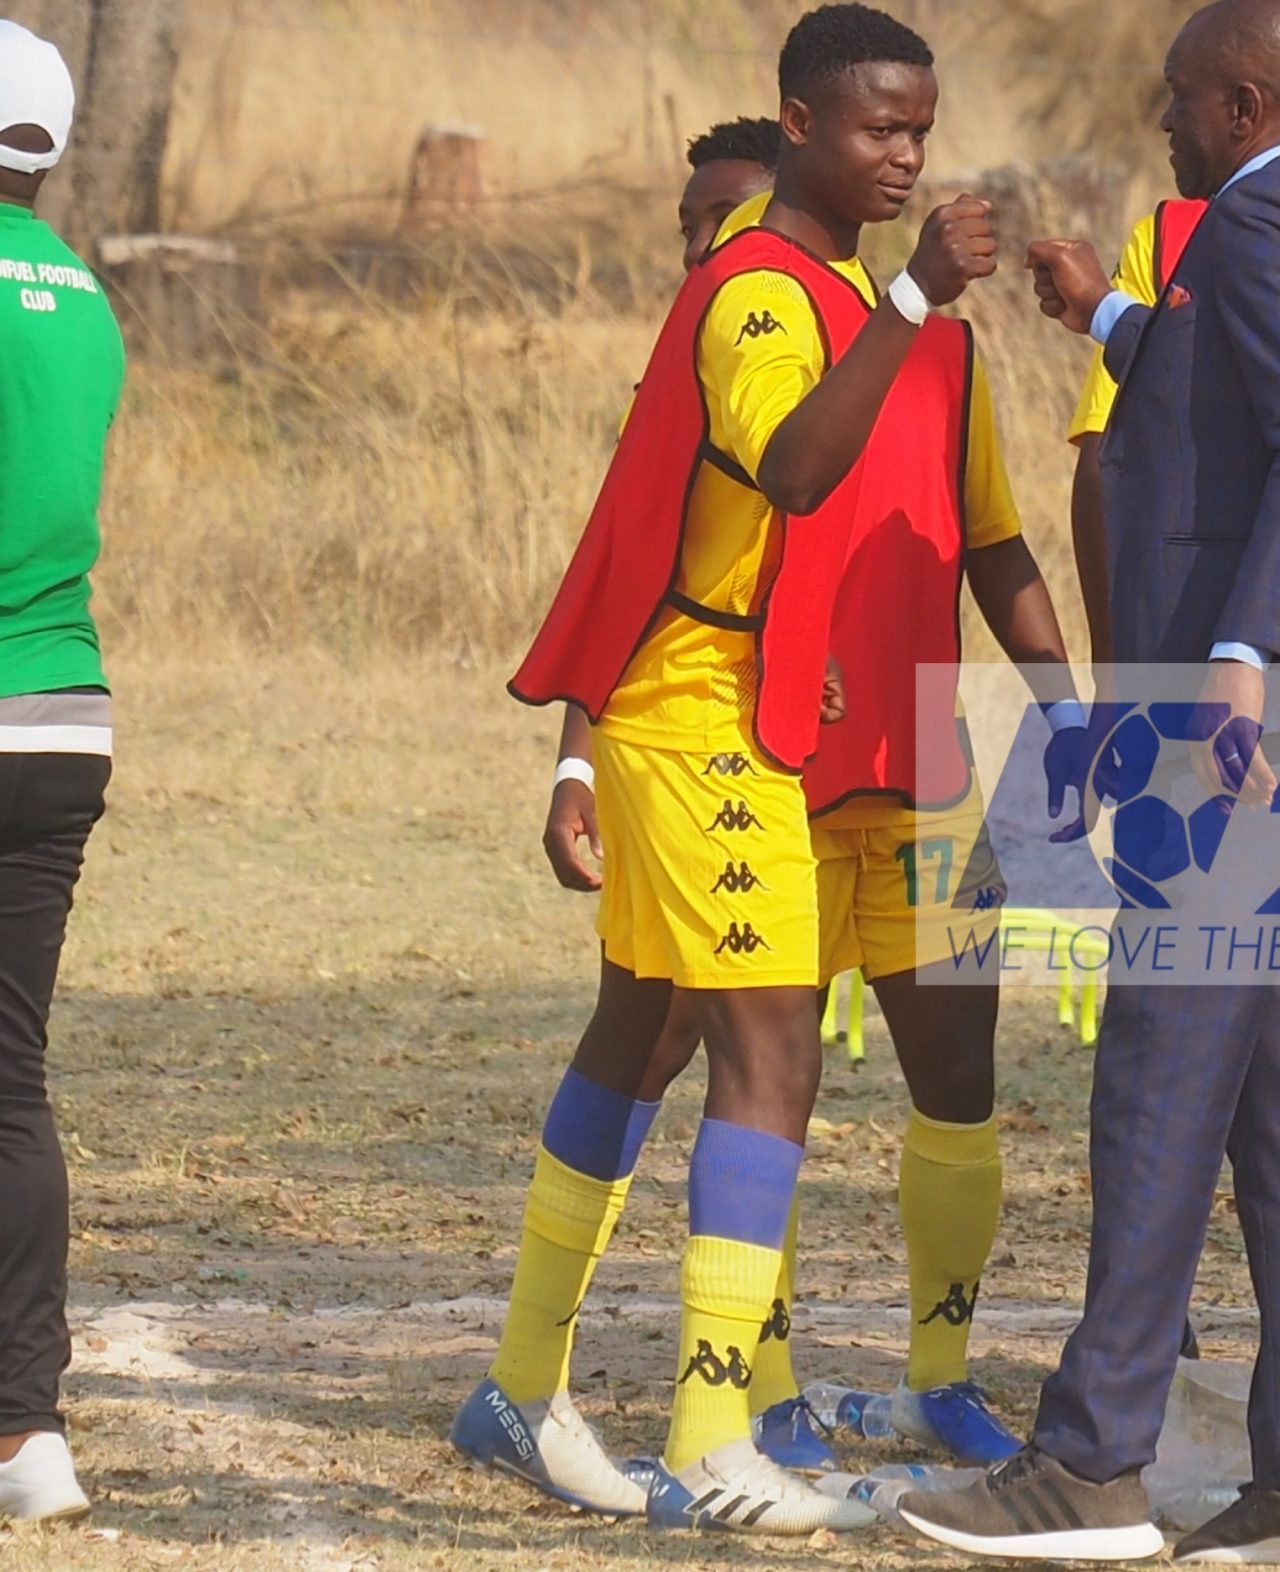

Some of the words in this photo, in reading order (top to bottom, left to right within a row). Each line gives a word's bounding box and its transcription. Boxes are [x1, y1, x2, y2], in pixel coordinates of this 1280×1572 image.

[37, 263, 98, 294] FOOTBALL
[20, 287, 57, 312] CLUB
[895, 838, 953, 907] 17
